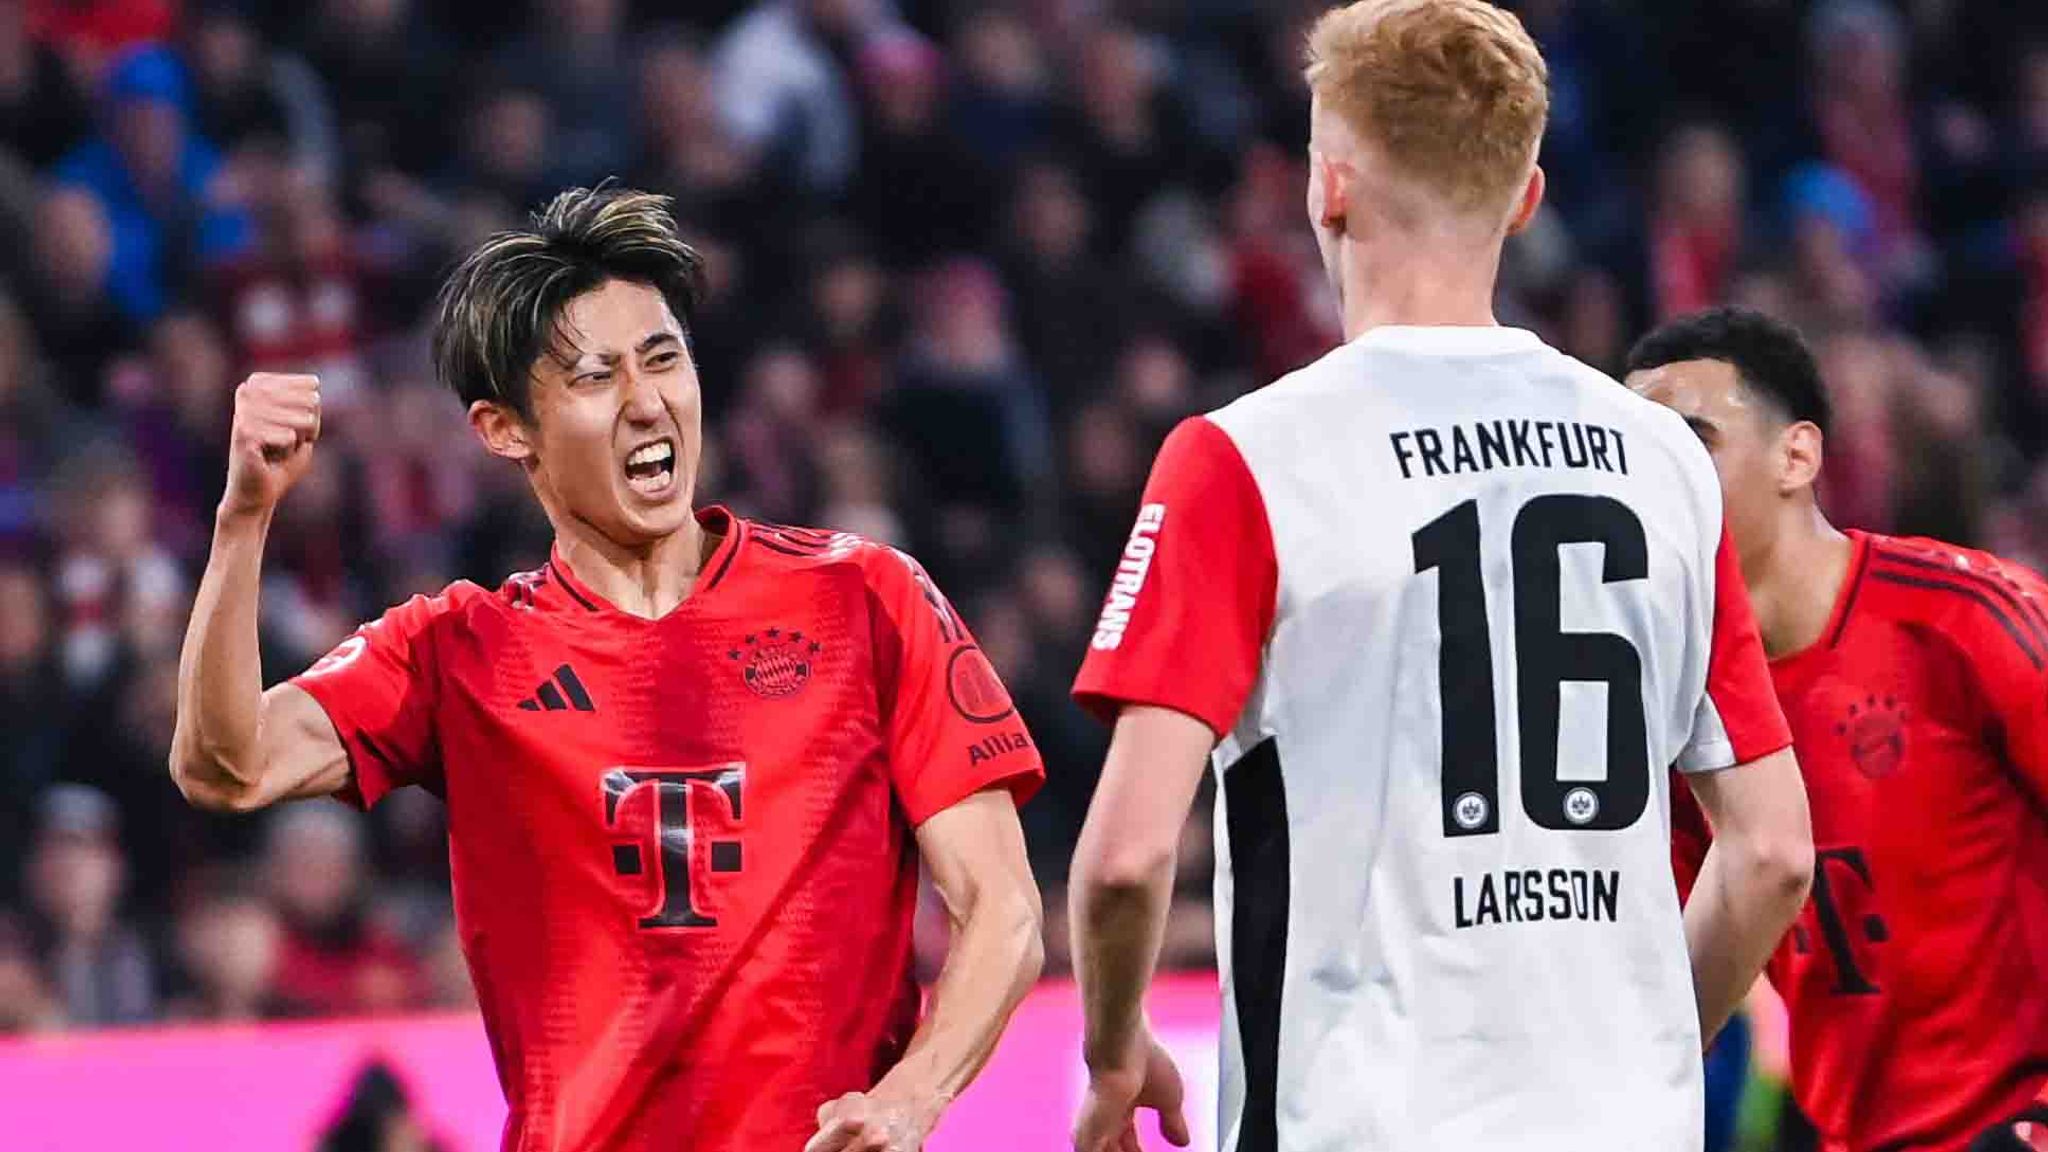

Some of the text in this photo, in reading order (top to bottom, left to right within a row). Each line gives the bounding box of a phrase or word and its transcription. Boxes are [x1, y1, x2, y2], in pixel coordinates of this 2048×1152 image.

[1389, 419, 1628, 478] FRANKFURT
[1091, 503, 1166, 650] ELOTRANS
[1411, 493, 1651, 838] 16
[602, 762, 746, 930] T
[1454, 868, 1620, 928] LARSSON
